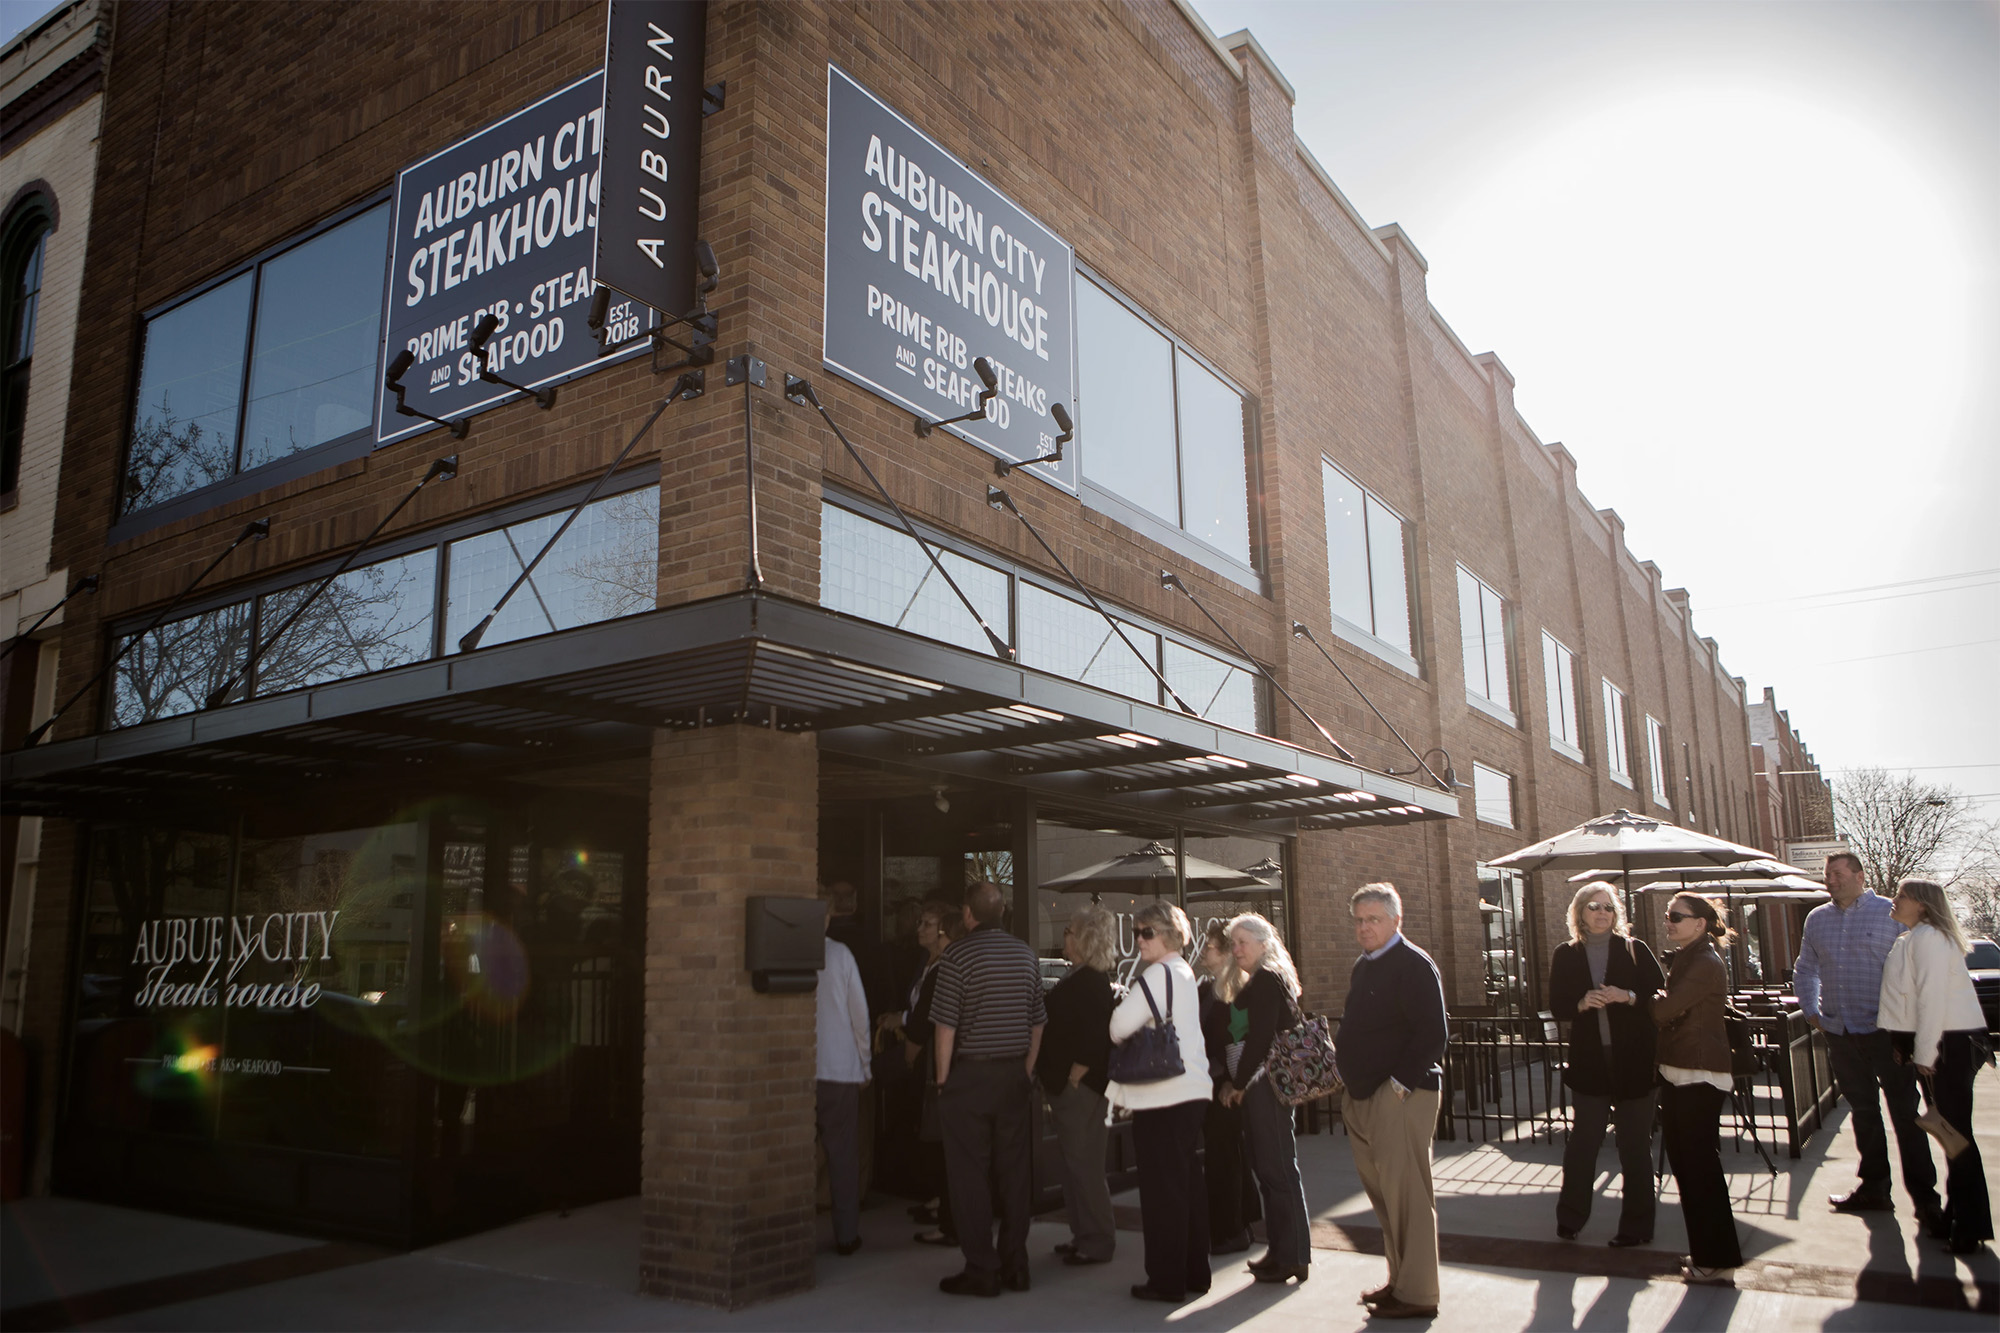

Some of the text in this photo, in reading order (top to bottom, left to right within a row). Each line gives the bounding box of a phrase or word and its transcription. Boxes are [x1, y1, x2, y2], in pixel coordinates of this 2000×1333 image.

[637, 22, 674, 269] AUBURN
[414, 107, 602, 239] AUBURN CIT
[864, 134, 1046, 295] AUBURN CITY
[861, 191, 1049, 362] STEAKHOUSE
[605, 316, 640, 345] 2018
[610, 301, 633, 324] EST.
[867, 284, 932, 350] PRIME
[936, 325, 967, 370] RIB
[407, 315, 469, 369] PRIME
[896, 345, 916, 368] AND
[430, 364, 451, 385] AND
[1040, 432, 1055, 452] EST.
[131, 910, 340, 964] AUBURN CITY
[242, 1059, 282, 1075] SEAFOOD
